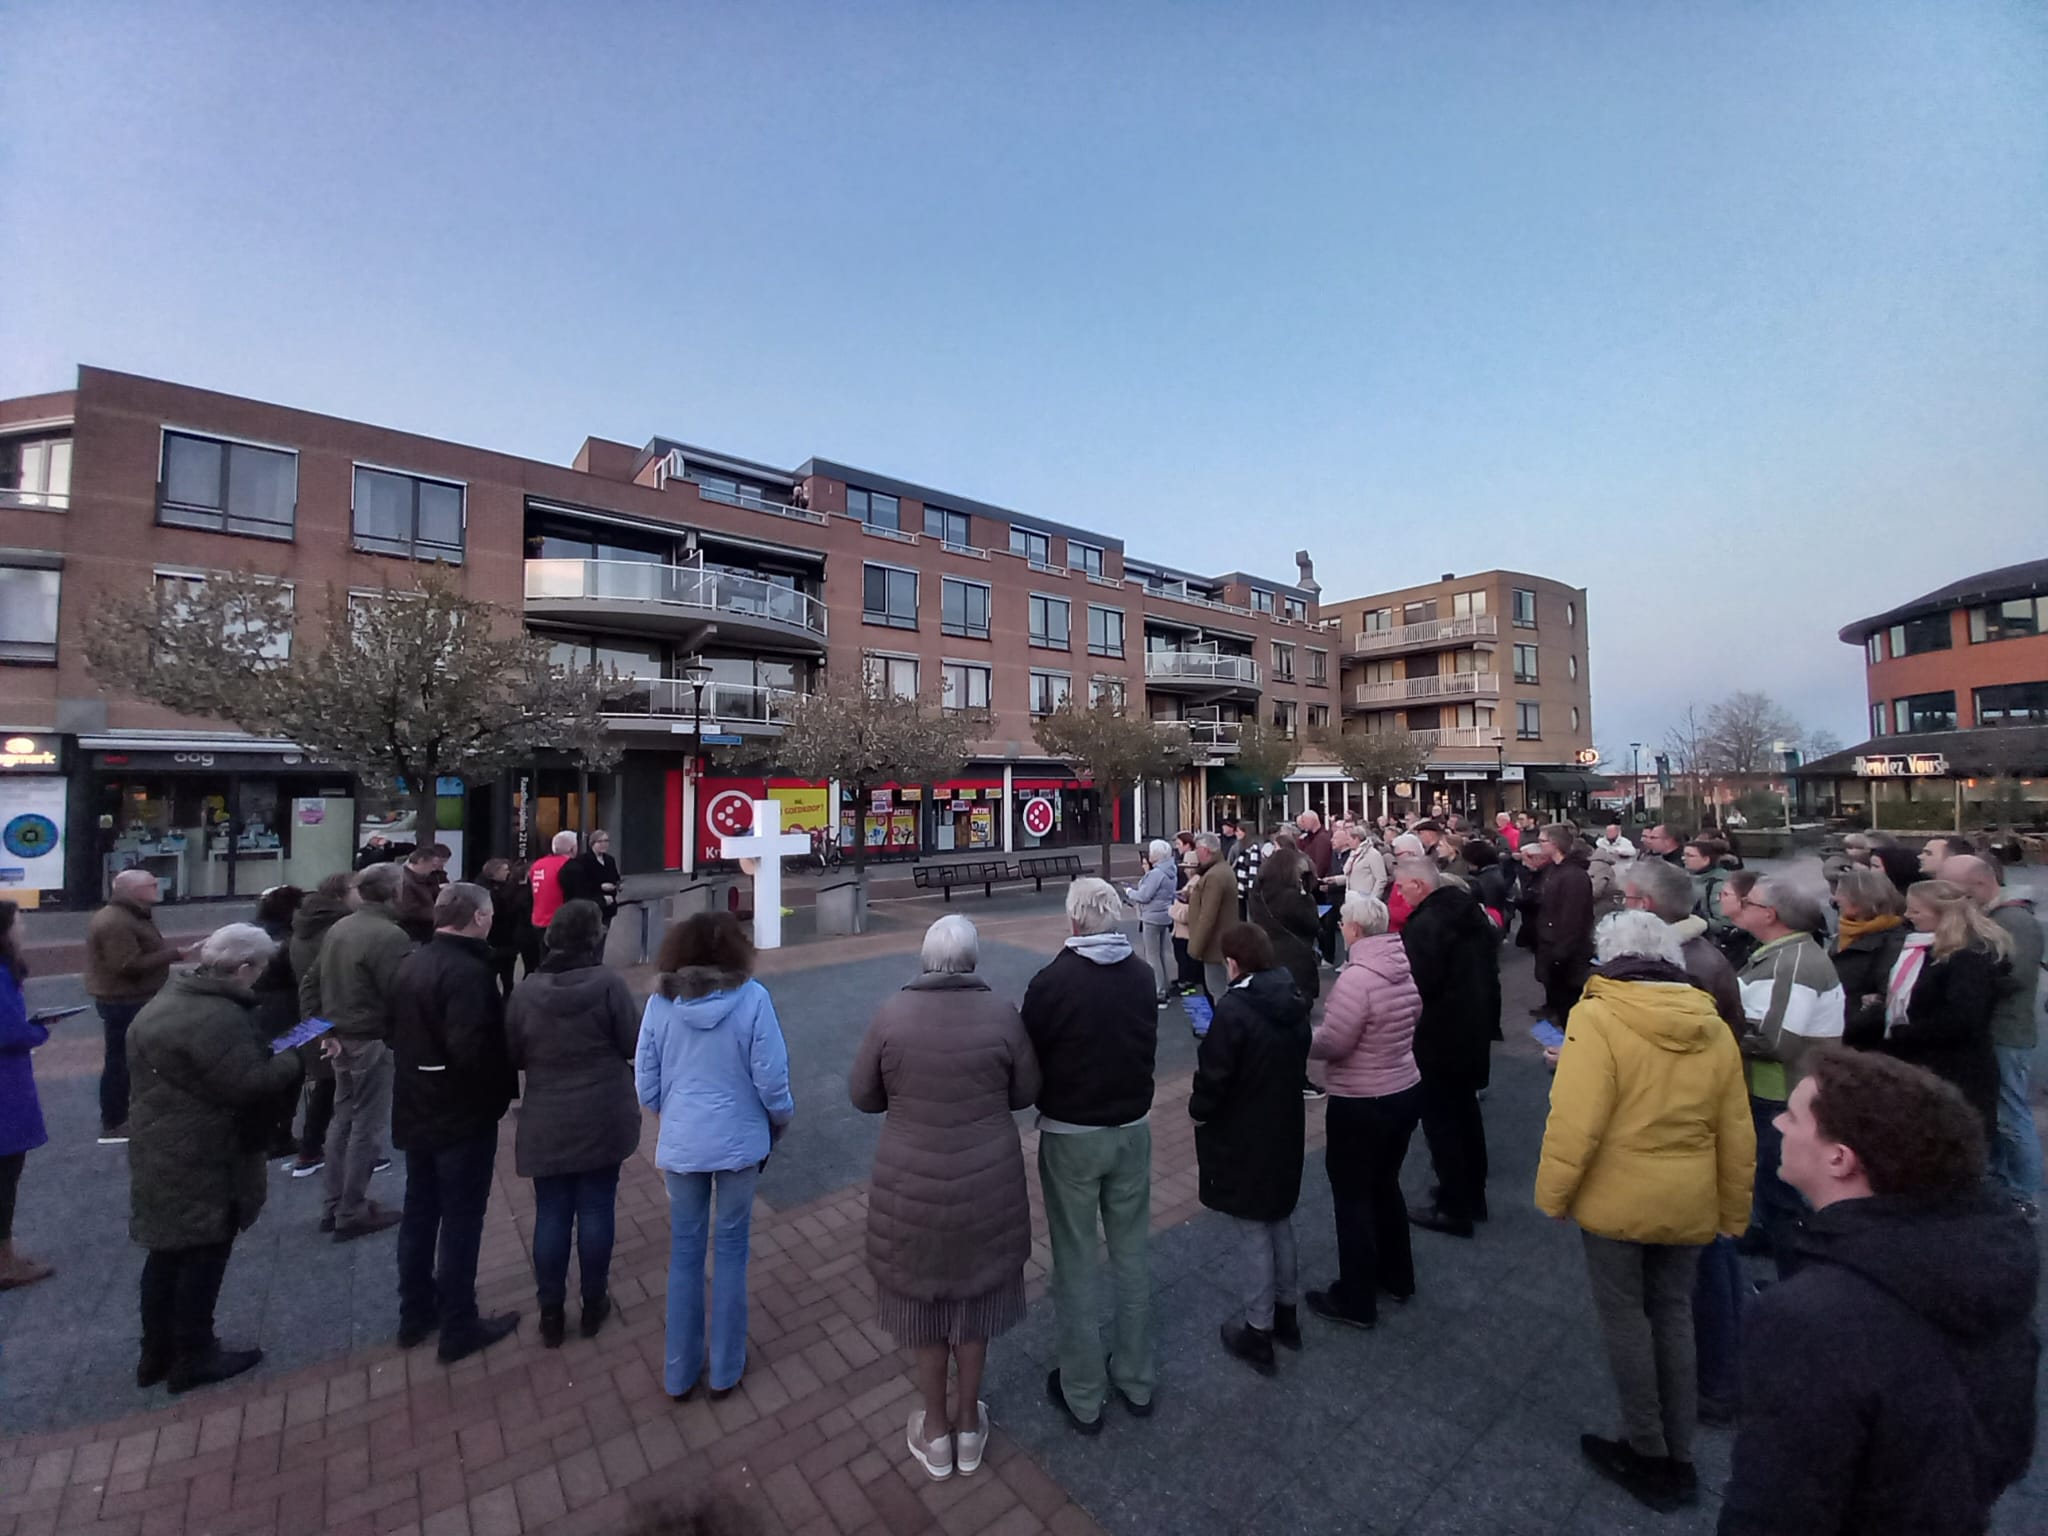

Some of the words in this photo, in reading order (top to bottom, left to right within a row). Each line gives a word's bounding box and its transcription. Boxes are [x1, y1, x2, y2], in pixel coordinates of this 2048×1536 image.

[174, 752, 215, 767] oog
[1857, 755, 1904, 776] Rendez
[1907, 754, 1942, 775] Vous
